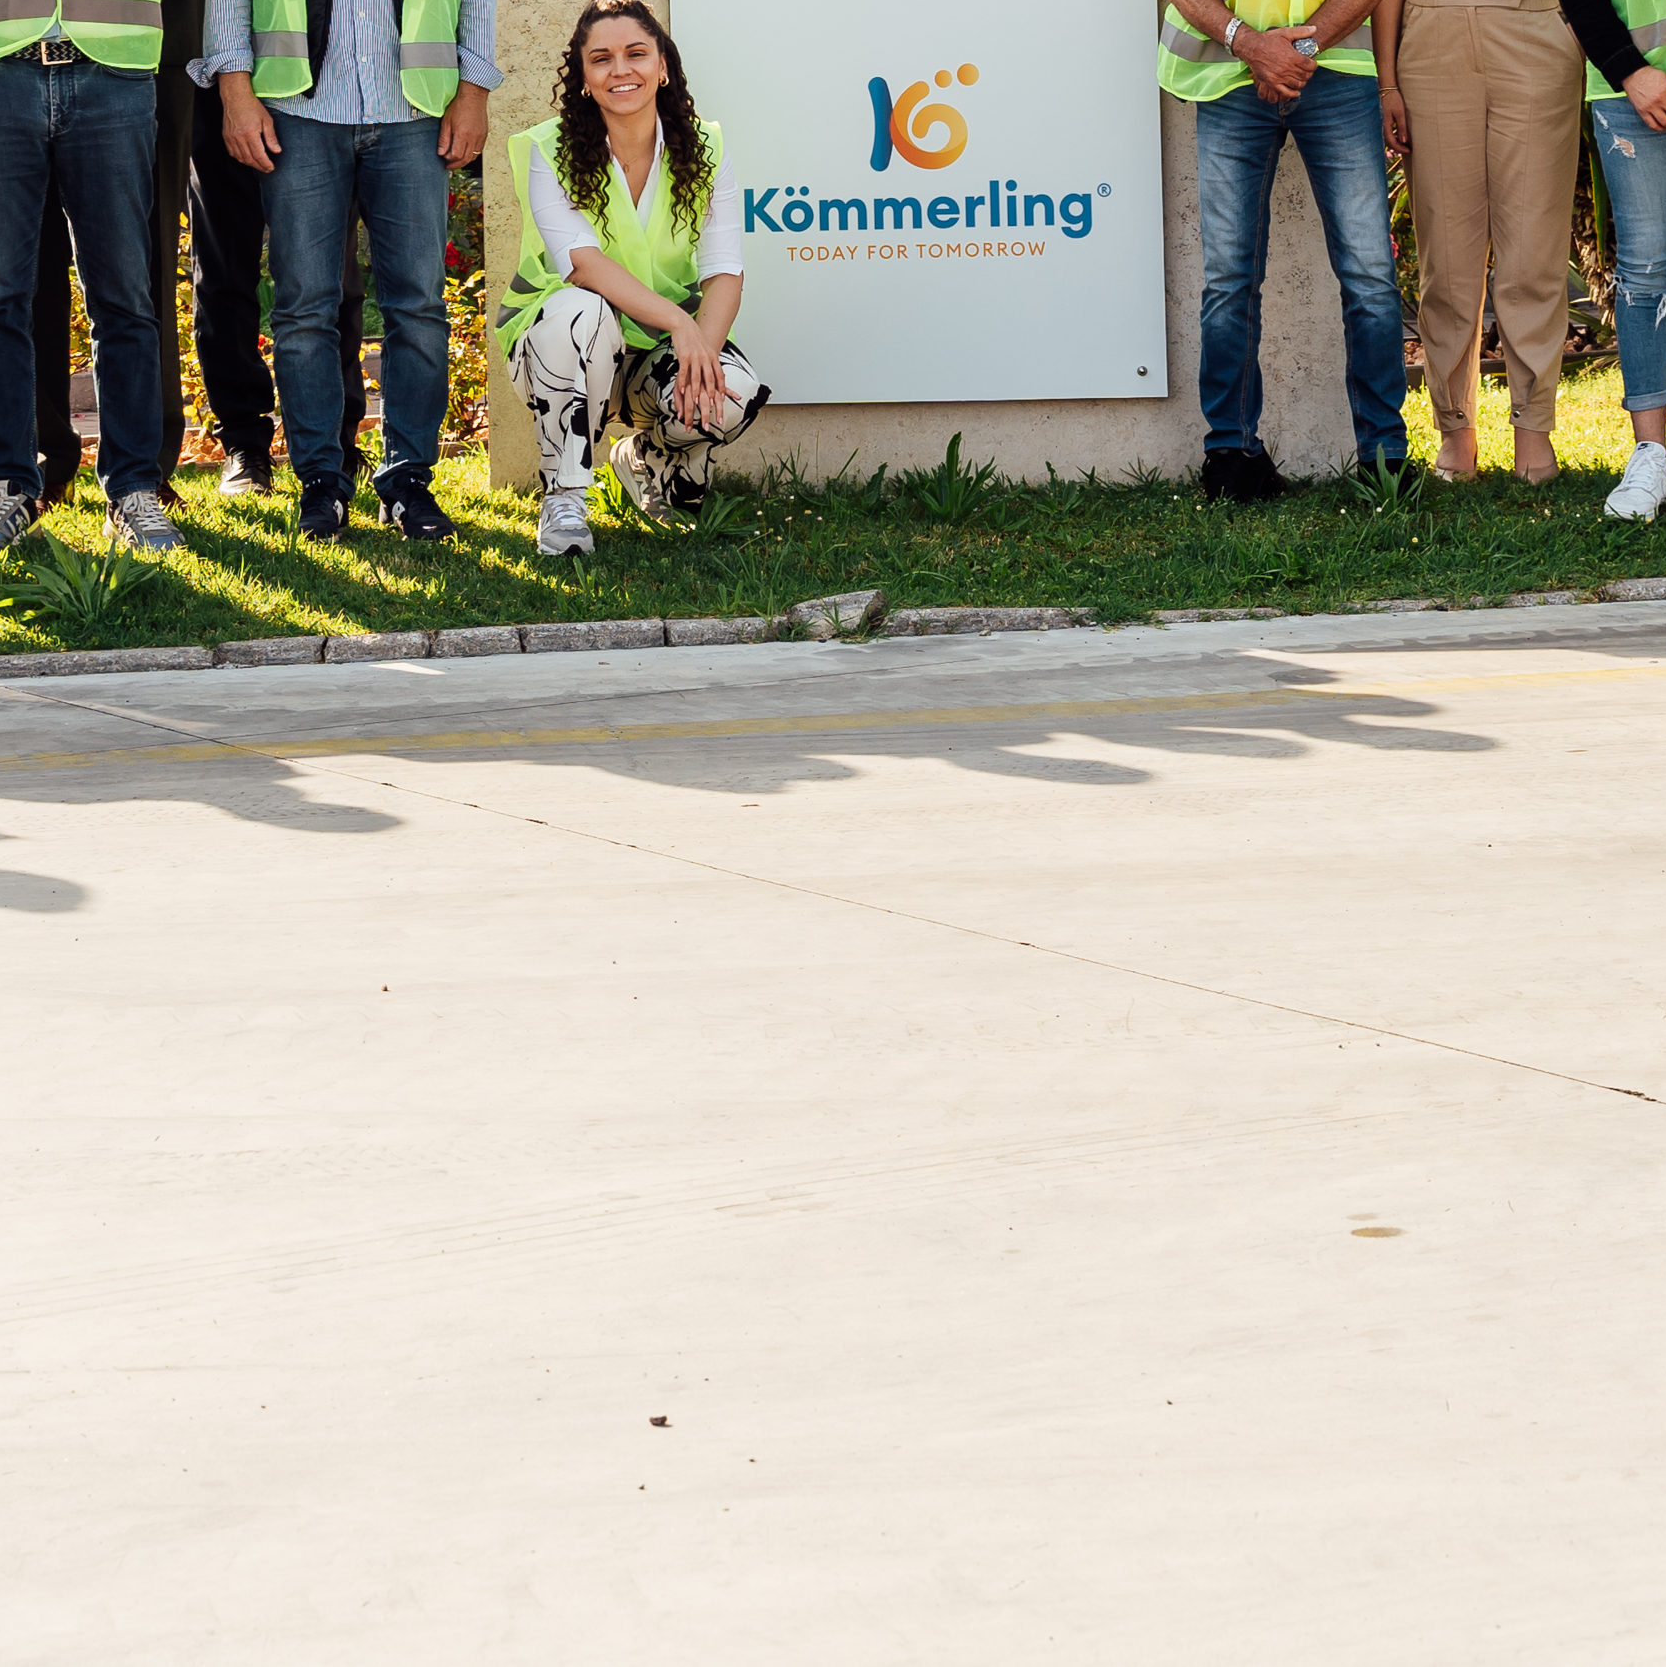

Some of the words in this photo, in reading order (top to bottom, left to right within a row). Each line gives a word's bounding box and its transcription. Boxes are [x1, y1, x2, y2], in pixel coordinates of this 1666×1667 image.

[786, 244, 859, 262] TODAY
[866, 243, 909, 260] FOR
[915, 241, 1046, 259] TOMORROW
